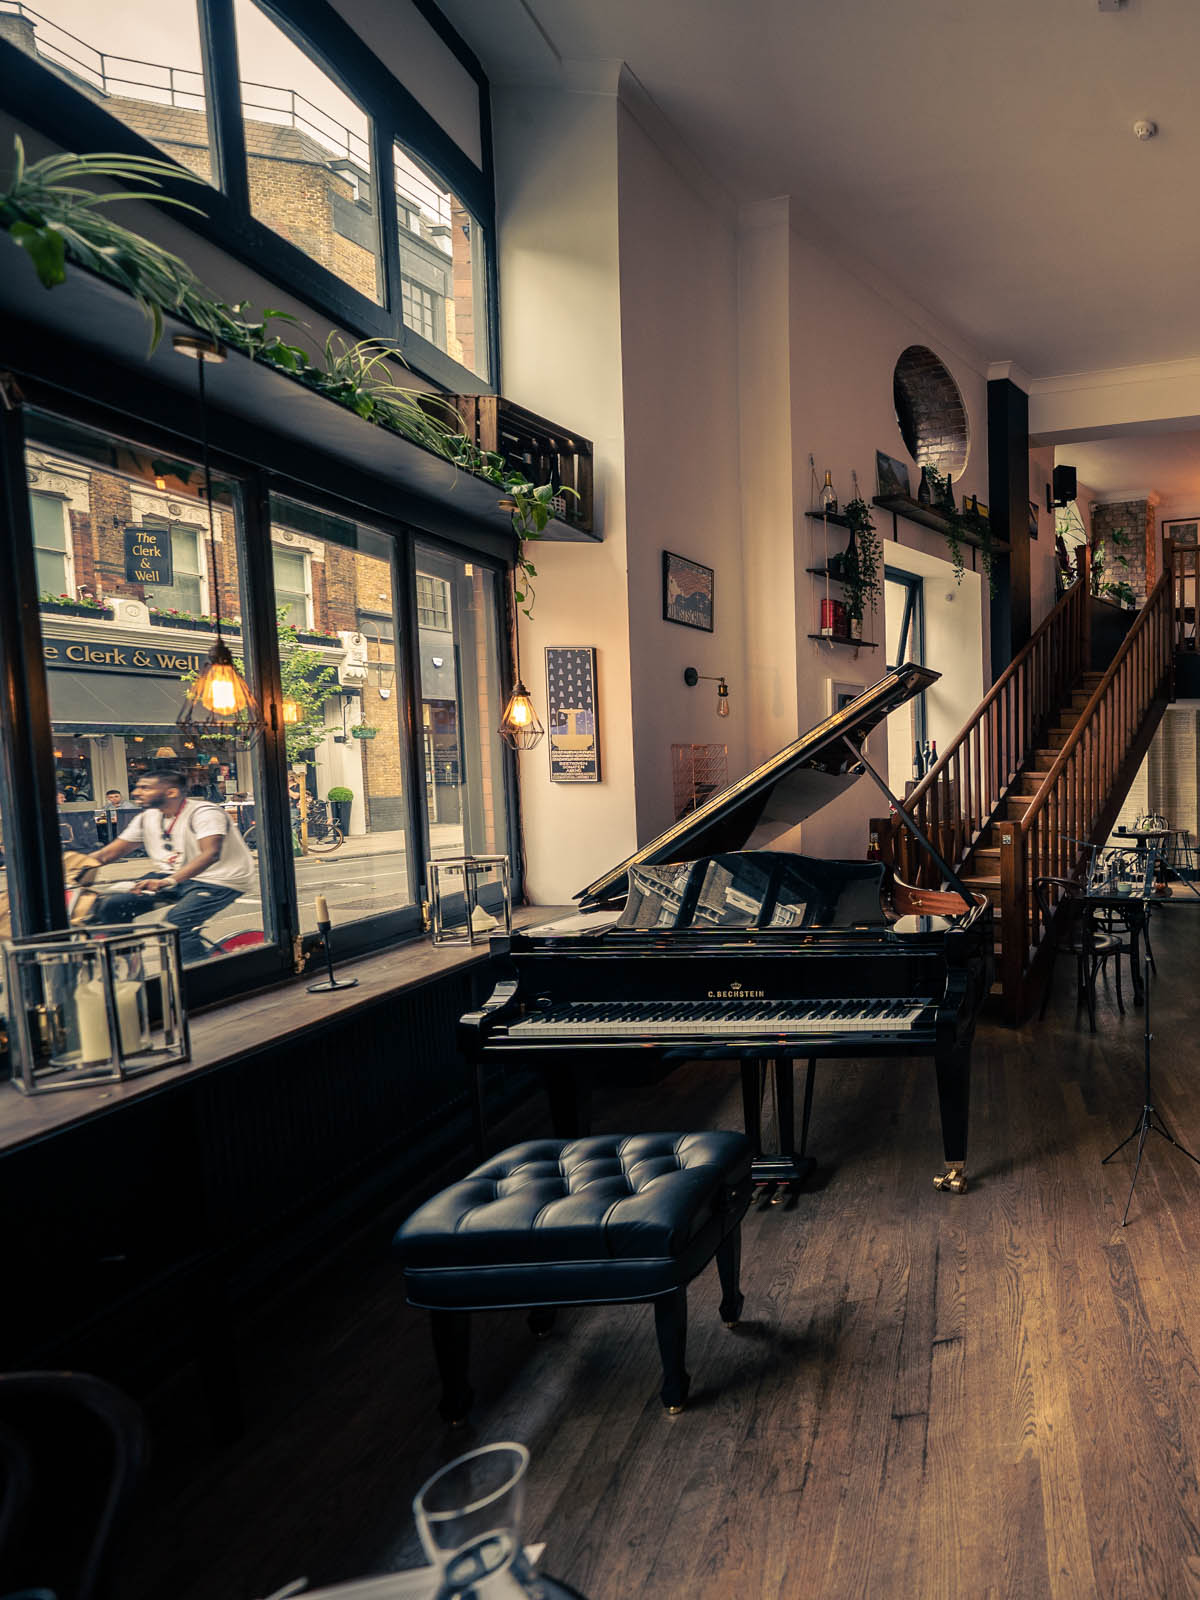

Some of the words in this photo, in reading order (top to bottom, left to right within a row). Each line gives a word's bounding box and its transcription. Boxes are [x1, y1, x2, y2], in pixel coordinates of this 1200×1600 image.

[136, 532, 157, 544] The
[132, 545, 161, 557] Clerk
[140, 558, 151, 569] &
[135, 570, 160, 582] Well
[66, 645, 128, 665] Clerk
[132, 650, 152, 667] &
[156, 653, 200, 671] Well
